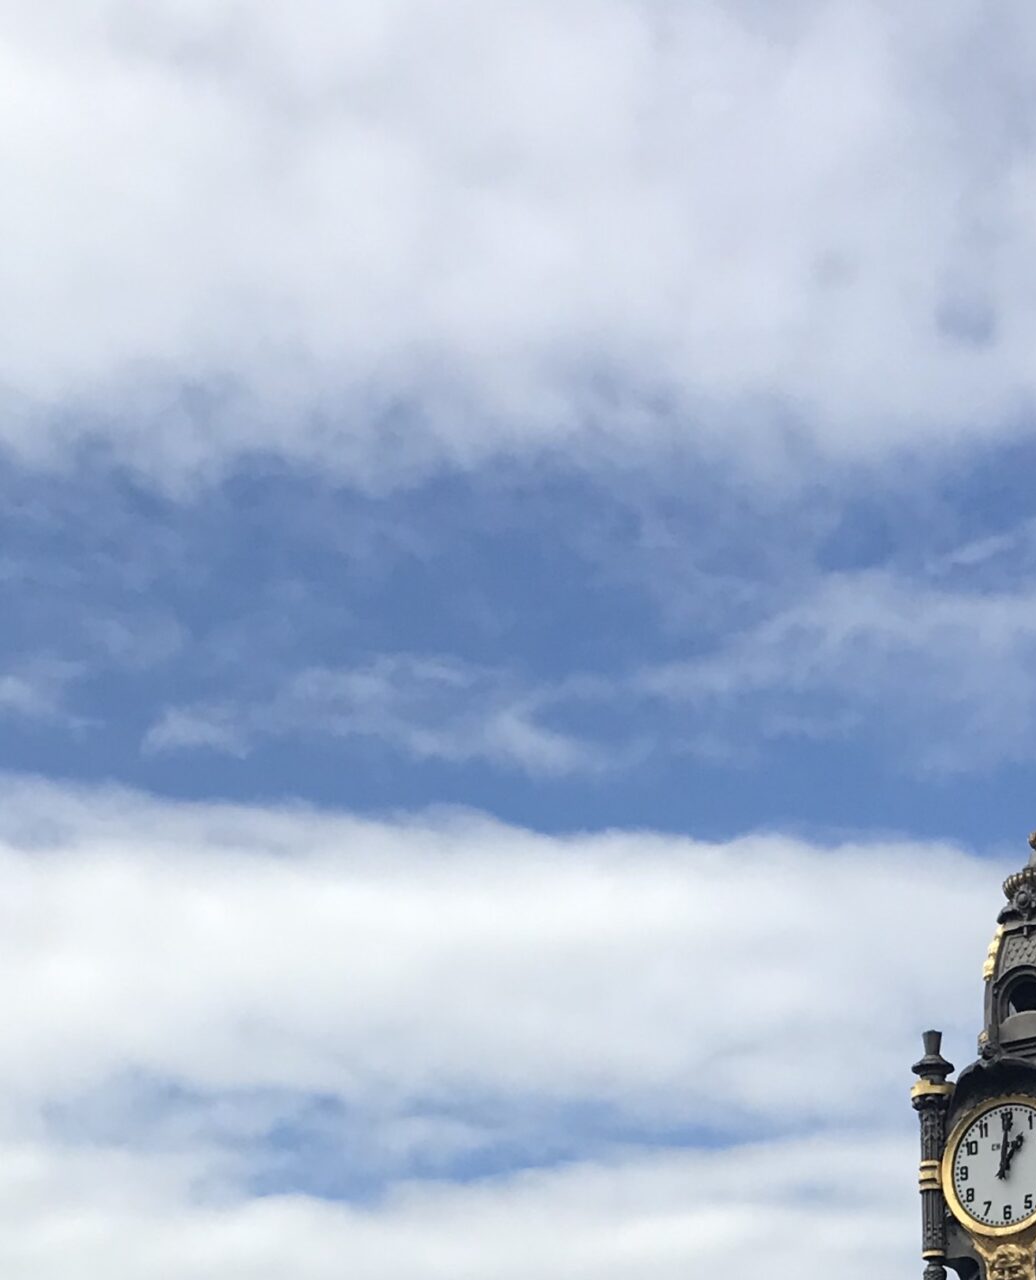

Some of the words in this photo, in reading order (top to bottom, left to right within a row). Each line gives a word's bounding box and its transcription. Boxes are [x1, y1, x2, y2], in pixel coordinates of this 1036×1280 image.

[1028, 1114, 1033, 1130] 1
[979, 1122, 988, 1138] 11
[966, 1141, 978, 1156] 10
[960, 1166, 968, 1181] 9
[966, 1188, 975, 1202] 8
[1024, 1194, 1033, 1209] 5
[983, 1201, 992, 1216] 7
[1003, 1205, 1012, 1220] 6
